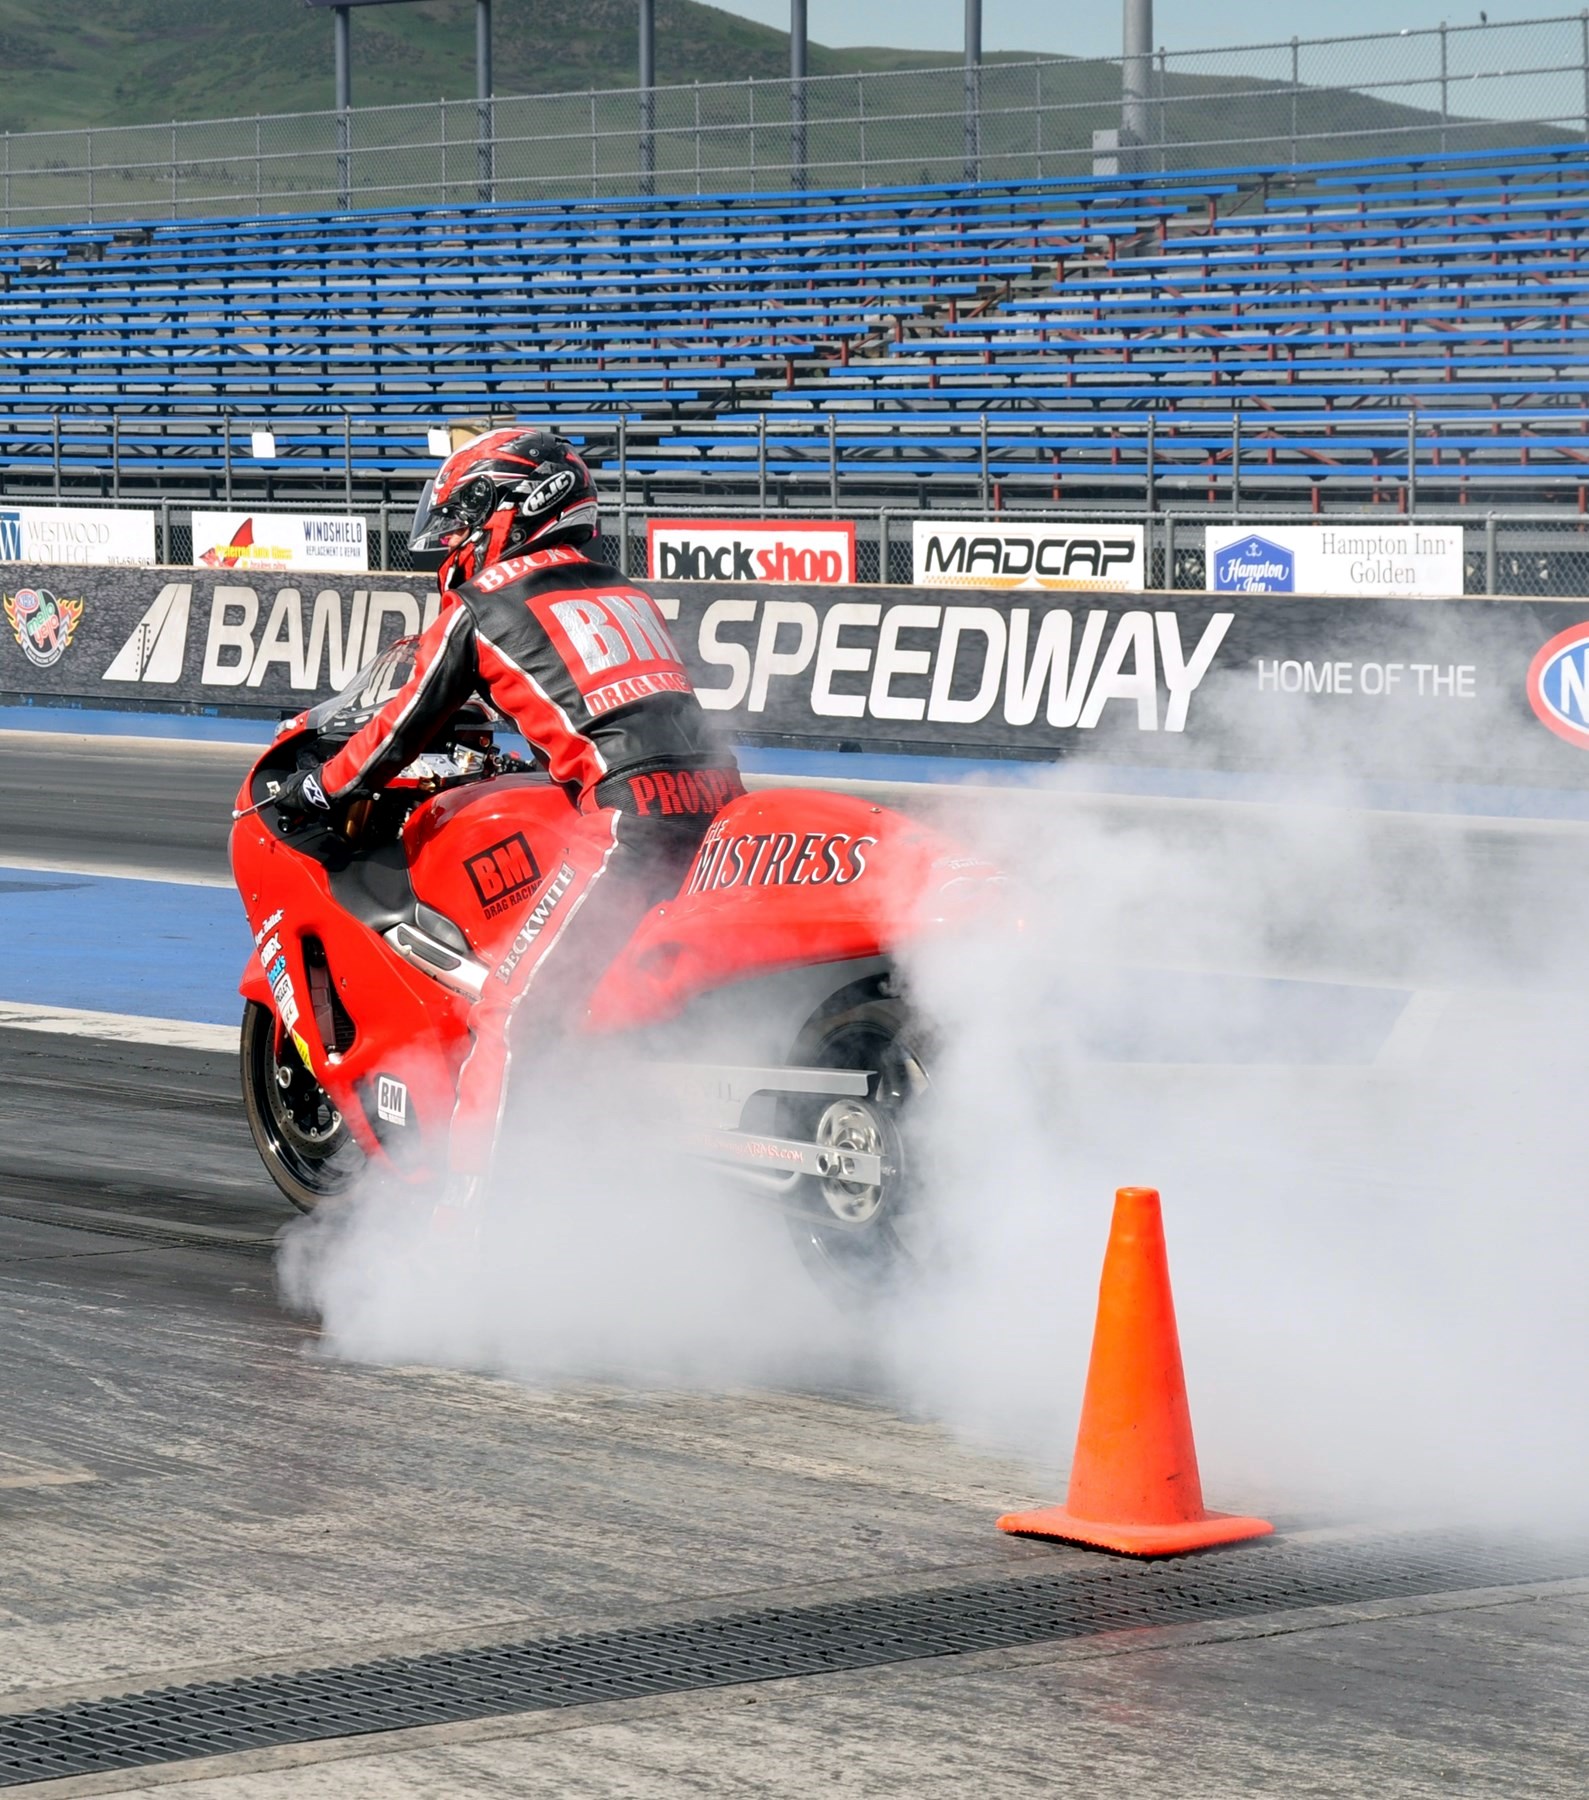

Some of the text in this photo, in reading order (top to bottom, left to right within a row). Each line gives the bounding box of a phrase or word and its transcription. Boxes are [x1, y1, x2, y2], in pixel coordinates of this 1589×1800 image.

[529, 472, 569, 511] HJC
[28, 520, 110, 544] WESTWOOD
[303, 520, 363, 544] WINDSHIELD
[1321, 533, 1447, 561] Hampton Inn
[28, 544, 96, 564] COLLEGE
[305, 545, 336, 556] REPLACEMENT
[344, 547, 361, 557] REPAIR
[924, 536, 1136, 577] MADCAP
[1220, 558, 1289, 583] Hampton
[1349, 561, 1416, 584] Golden
[549, 595, 684, 675] BM
[694, 599, 1235, 733] SPEEDWAY
[1258, 659, 1476, 697] HOME OF THE
[586, 678, 652, 716] DRAG
[470, 839, 534, 900] BM
[687, 833, 880, 895] MISTRESS
[484, 902, 509, 920] DRAG
[495, 860, 575, 985] BECKWITH
[380, 1081, 403, 1113] BM
